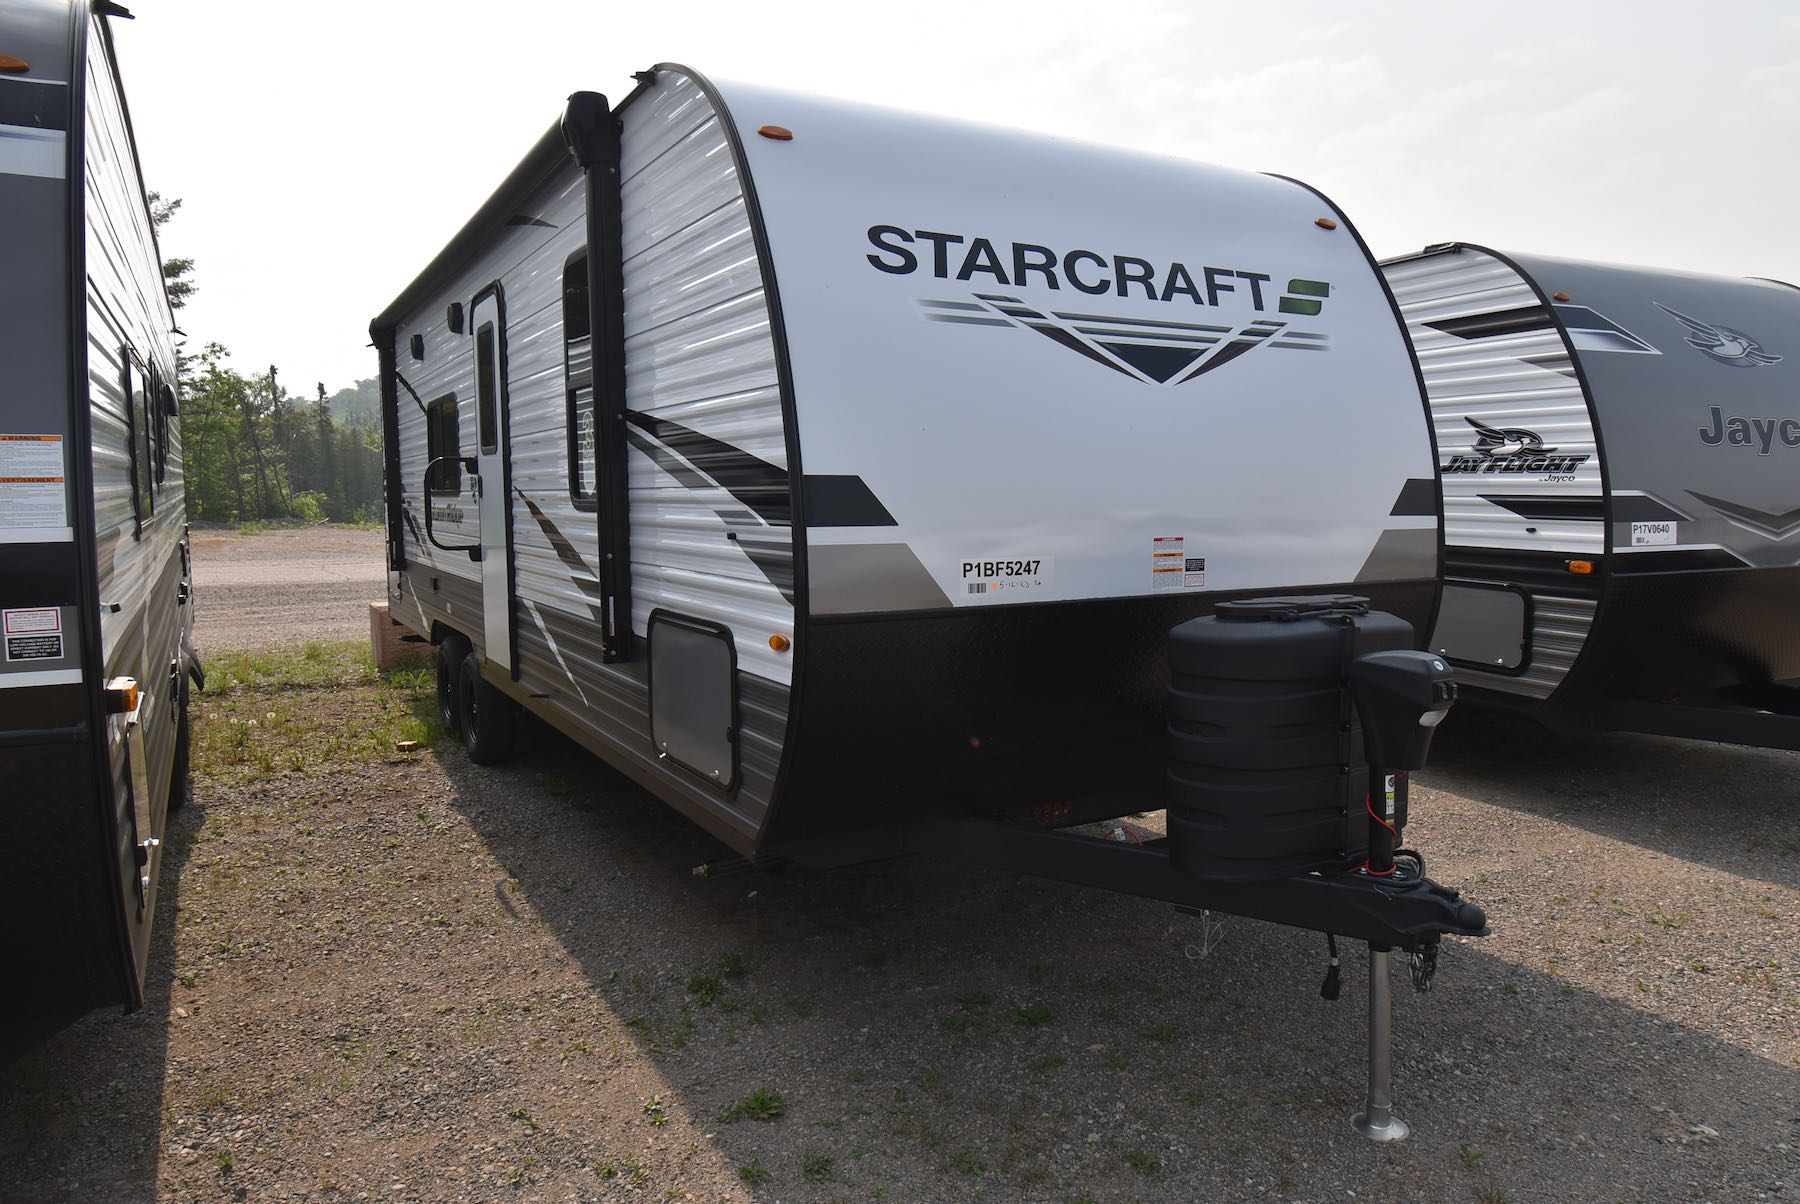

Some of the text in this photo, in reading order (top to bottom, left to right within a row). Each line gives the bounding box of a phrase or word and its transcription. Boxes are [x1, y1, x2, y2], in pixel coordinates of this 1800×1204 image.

[866, 224, 1271, 312] STARCRAFT
[1697, 405, 1800, 456] Jayc
[1544, 474, 1576, 484] Jayco
[1633, 524, 1670, 535] P17V0640
[963, 560, 1041, 578] P1BF5247
